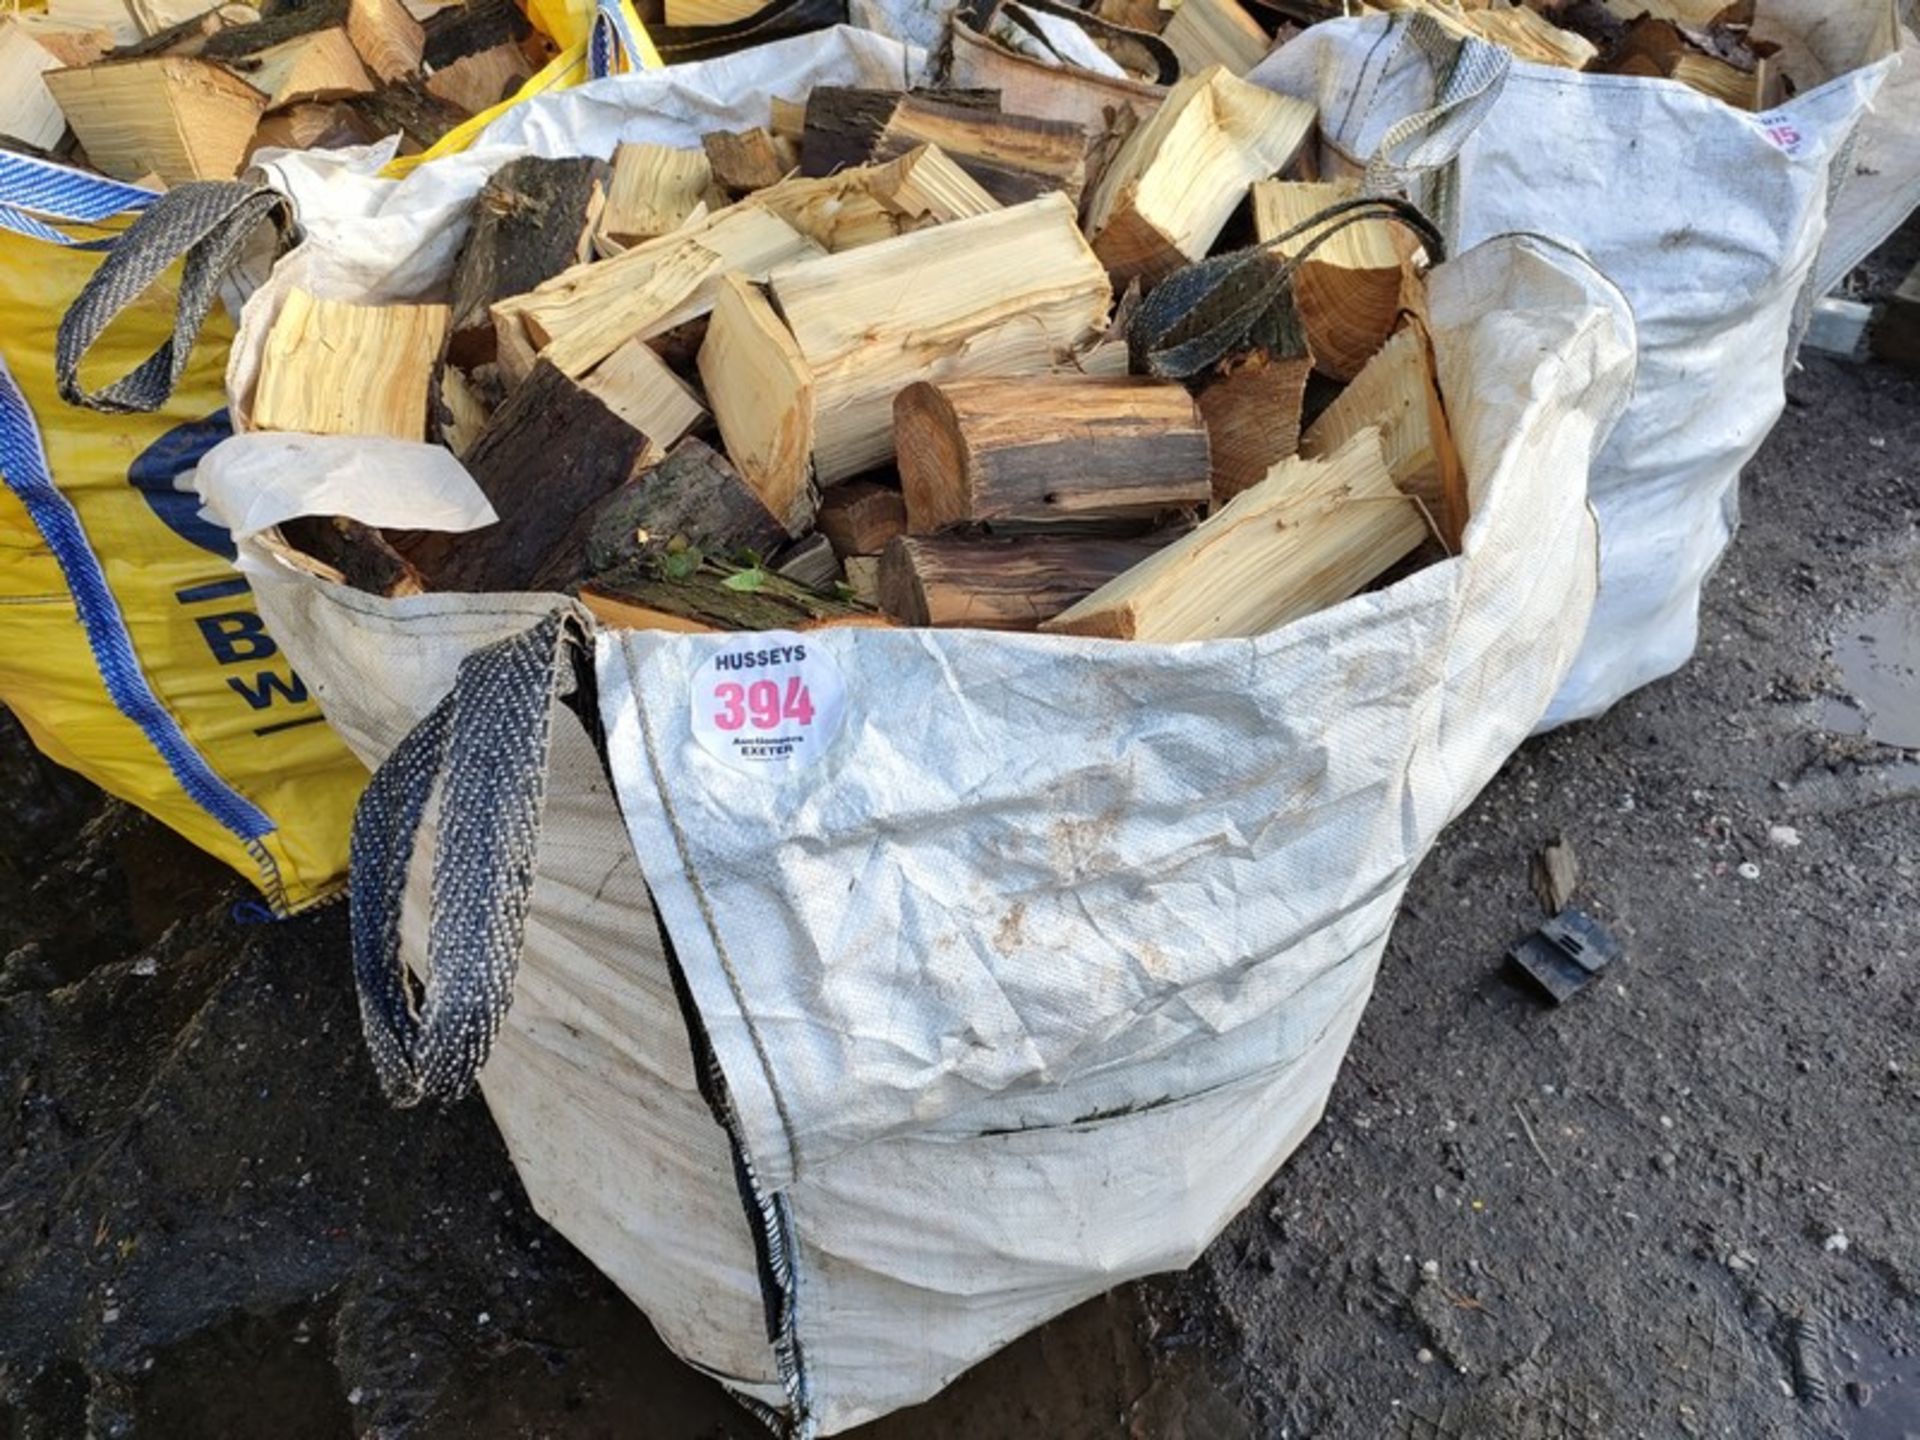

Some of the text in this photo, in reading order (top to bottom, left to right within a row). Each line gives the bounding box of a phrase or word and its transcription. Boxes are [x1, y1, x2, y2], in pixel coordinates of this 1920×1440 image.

[715, 645, 807, 671] HUSSEYS
[713, 676, 815, 730] 394
[741, 744, 794, 756] EXETER
